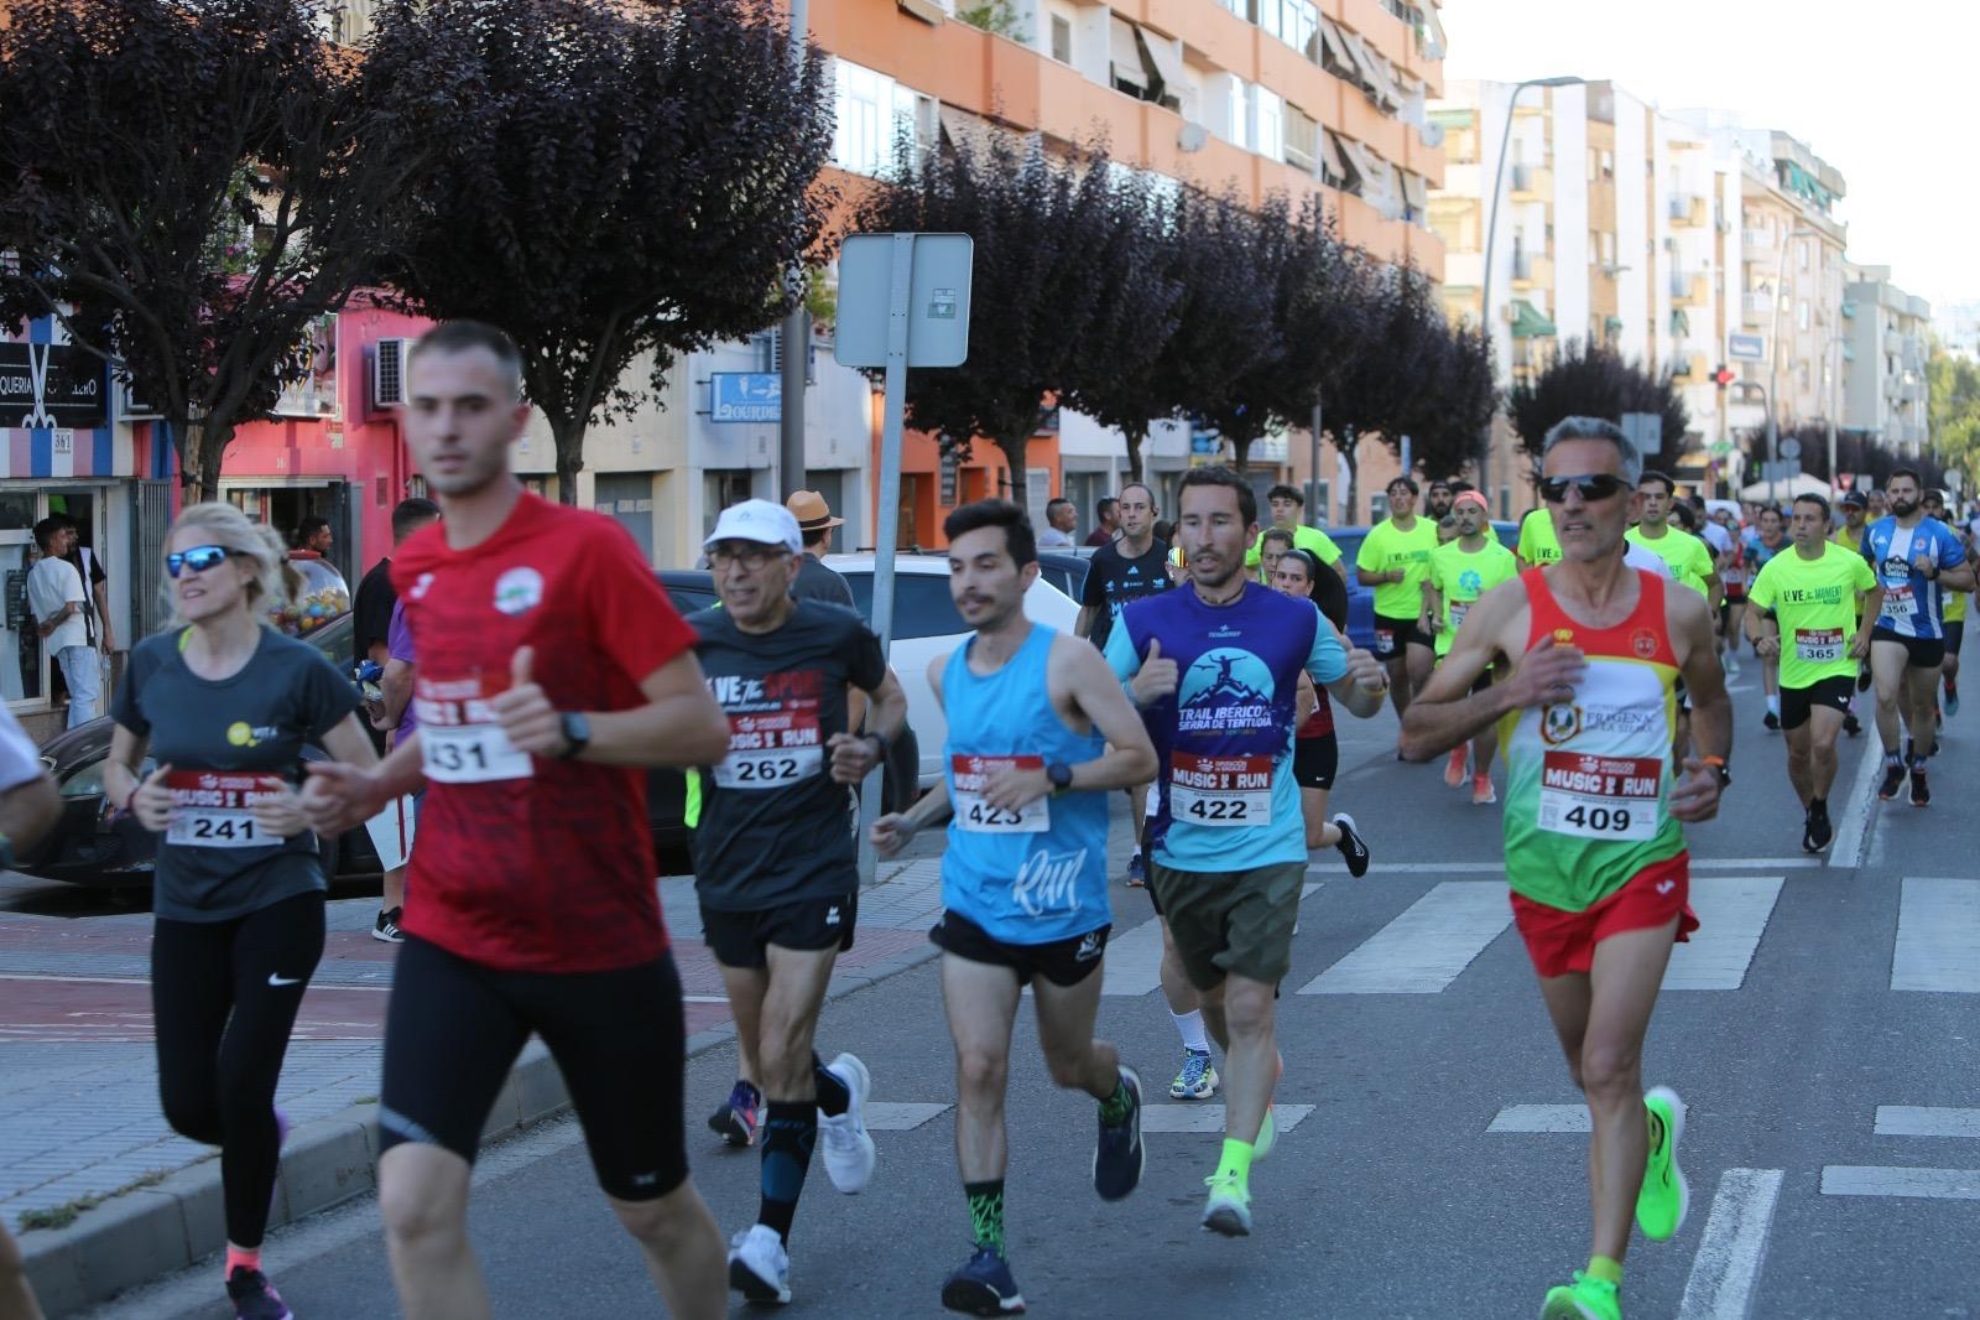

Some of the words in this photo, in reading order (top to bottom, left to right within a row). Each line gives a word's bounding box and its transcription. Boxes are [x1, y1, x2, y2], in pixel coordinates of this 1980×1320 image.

[1807, 649, 1834, 659] 365
[1178, 708, 1214, 721] TRAIL
[1178, 720, 1211, 731] SIERRA
[1212, 719, 1224, 729] DE
[781, 728, 818, 747] RUN
[737, 758, 799, 781] 262
[1173, 767, 1217, 788] MUSIC
[1236, 773, 1268, 789] RUN
[1545, 767, 1603, 793] MUSIC
[1622, 777, 1656, 795] RUN
[969, 804, 1022, 825] 423
[1189, 799, 1248, 819] 422
[1564, 805, 1631, 832] 409
[194, 819, 254, 840] 241
